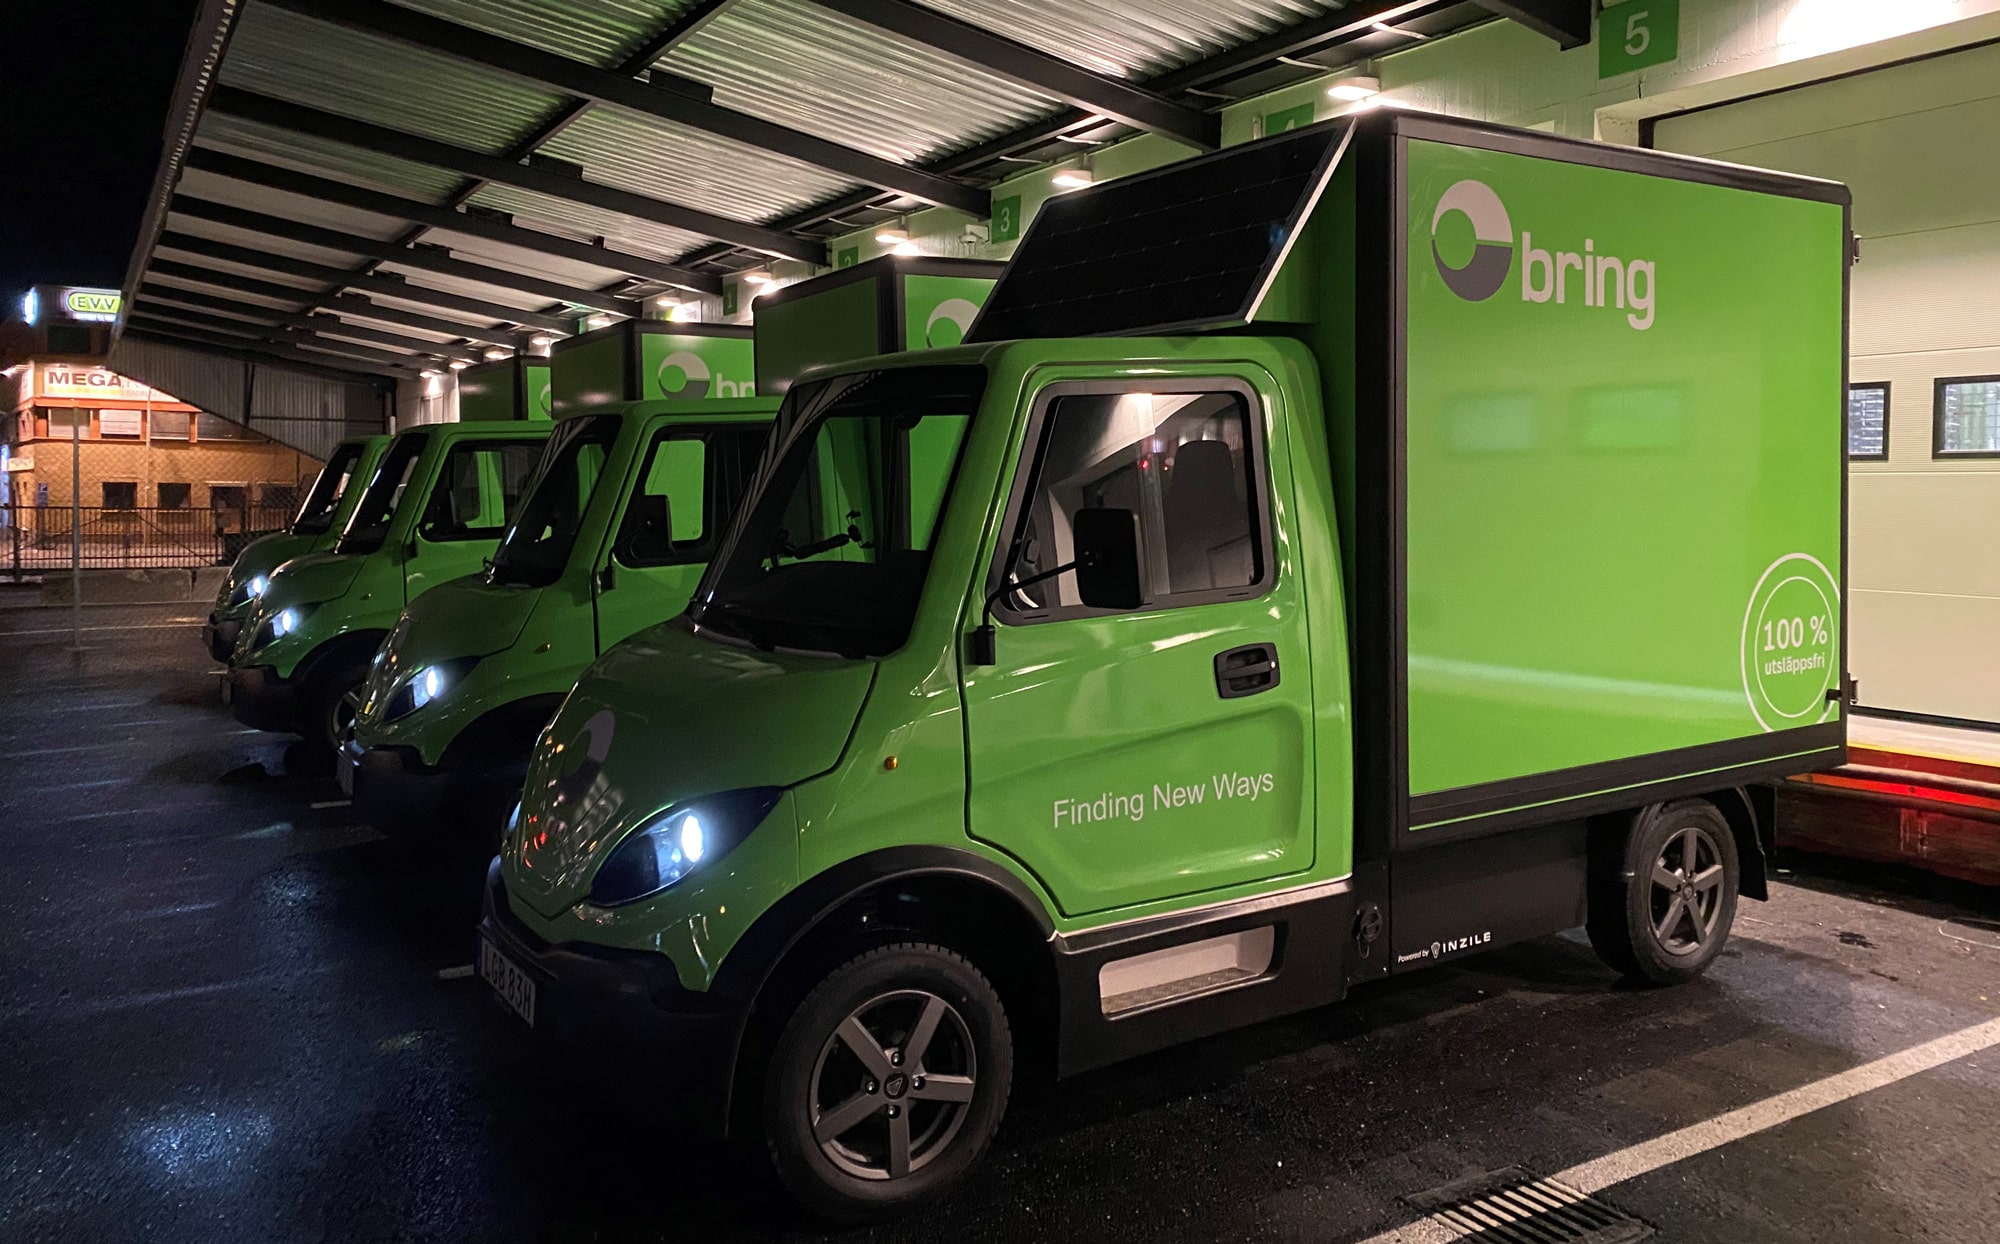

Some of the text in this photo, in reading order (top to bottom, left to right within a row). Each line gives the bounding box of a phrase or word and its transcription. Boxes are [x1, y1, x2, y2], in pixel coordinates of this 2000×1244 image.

[1624, 11, 1650, 55] 5
[1000, 207, 1010, 232] 3
[1522, 231, 1655, 330] bring
[48, 371, 122, 387] MEGA
[1764, 614, 1828, 651] 100 %
[1765, 652, 1825, 675] utsläppsfri
[1054, 772, 1274, 829] Finding New Ways
[1442, 932, 1491, 953] INZILE
